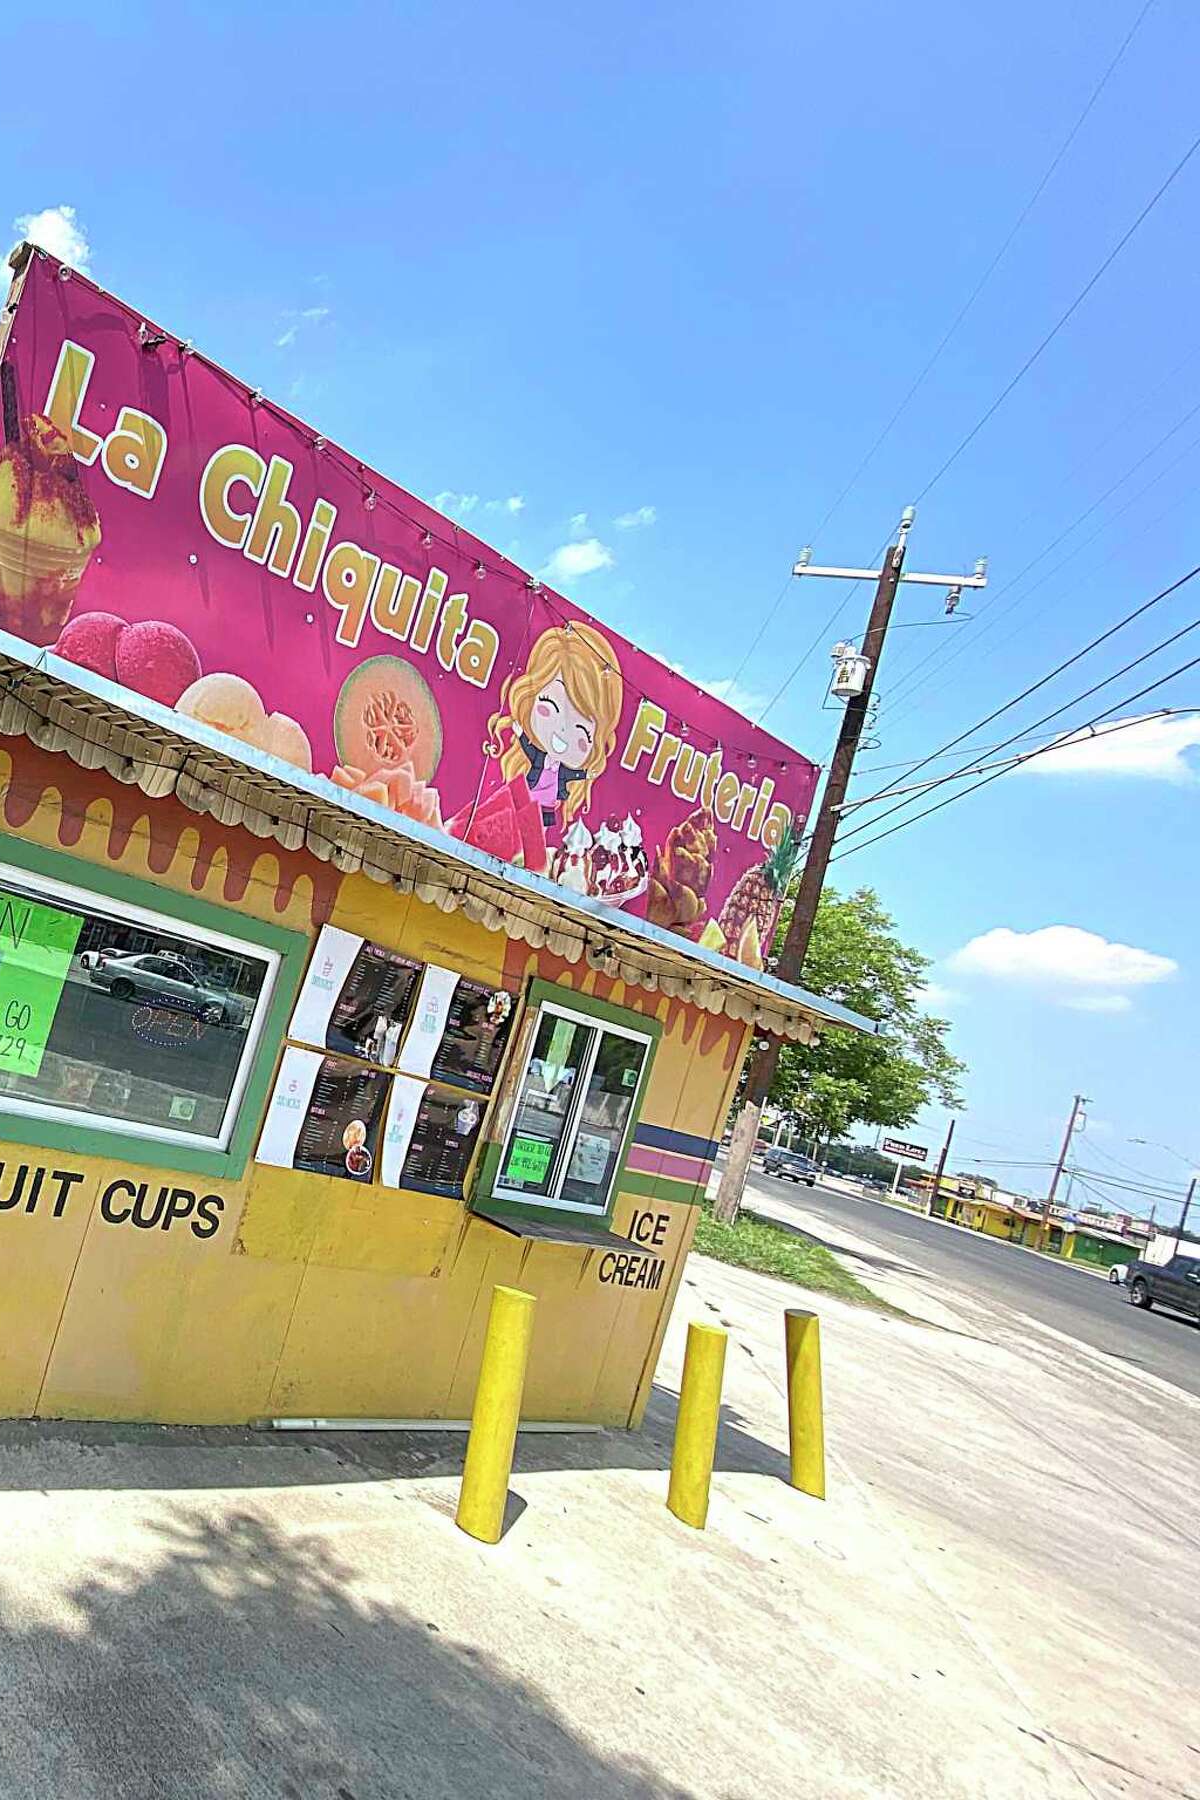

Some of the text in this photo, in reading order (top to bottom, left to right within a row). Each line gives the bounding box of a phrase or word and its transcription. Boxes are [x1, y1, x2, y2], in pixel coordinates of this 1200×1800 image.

[43, 340, 499, 689] La Chiquita
[620, 698, 792, 850] Fruteria
[5, 1000, 32, 1031] GO
[100, 1178, 225, 1240] CUPS
[628, 1210, 670, 1246] ICE
[599, 1252, 665, 1291] CREAM
